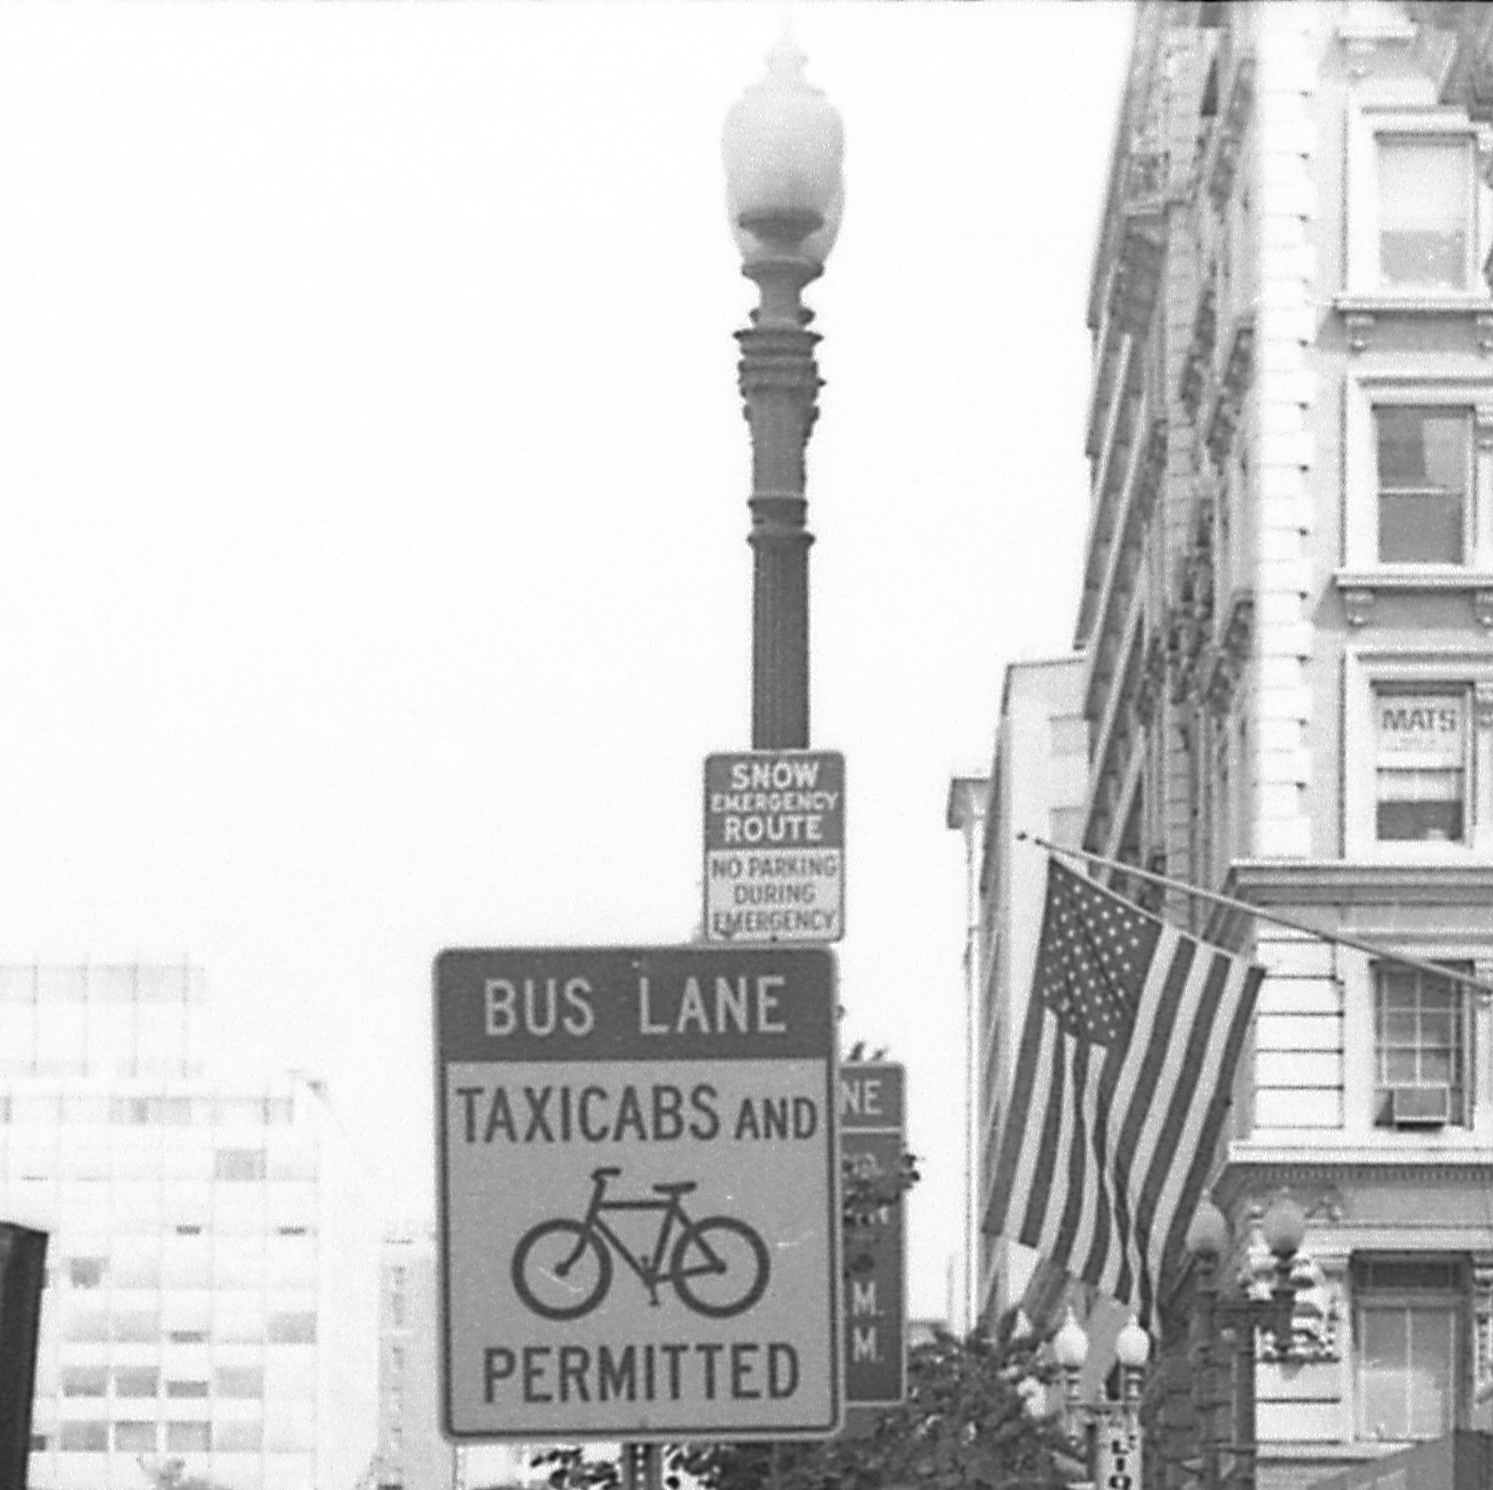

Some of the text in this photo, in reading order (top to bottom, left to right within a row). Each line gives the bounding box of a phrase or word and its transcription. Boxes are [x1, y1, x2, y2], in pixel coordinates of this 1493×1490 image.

[1382, 708, 1457, 732] MATS
[731, 762, 820, 790] SNOW
[710, 791, 839, 813] EMERGENCY
[724, 816, 823, 842] ROUTE
[712, 855, 837, 878] NO PARKING
[733, 884, 816, 904] DURING
[713, 911, 837, 931] EMERGENCY
[484, 976, 788, 1037] BUS LANE
[456, 1085, 819, 1143] TAXICABS AND
[482, 1343, 800, 1402] PERMITTED
